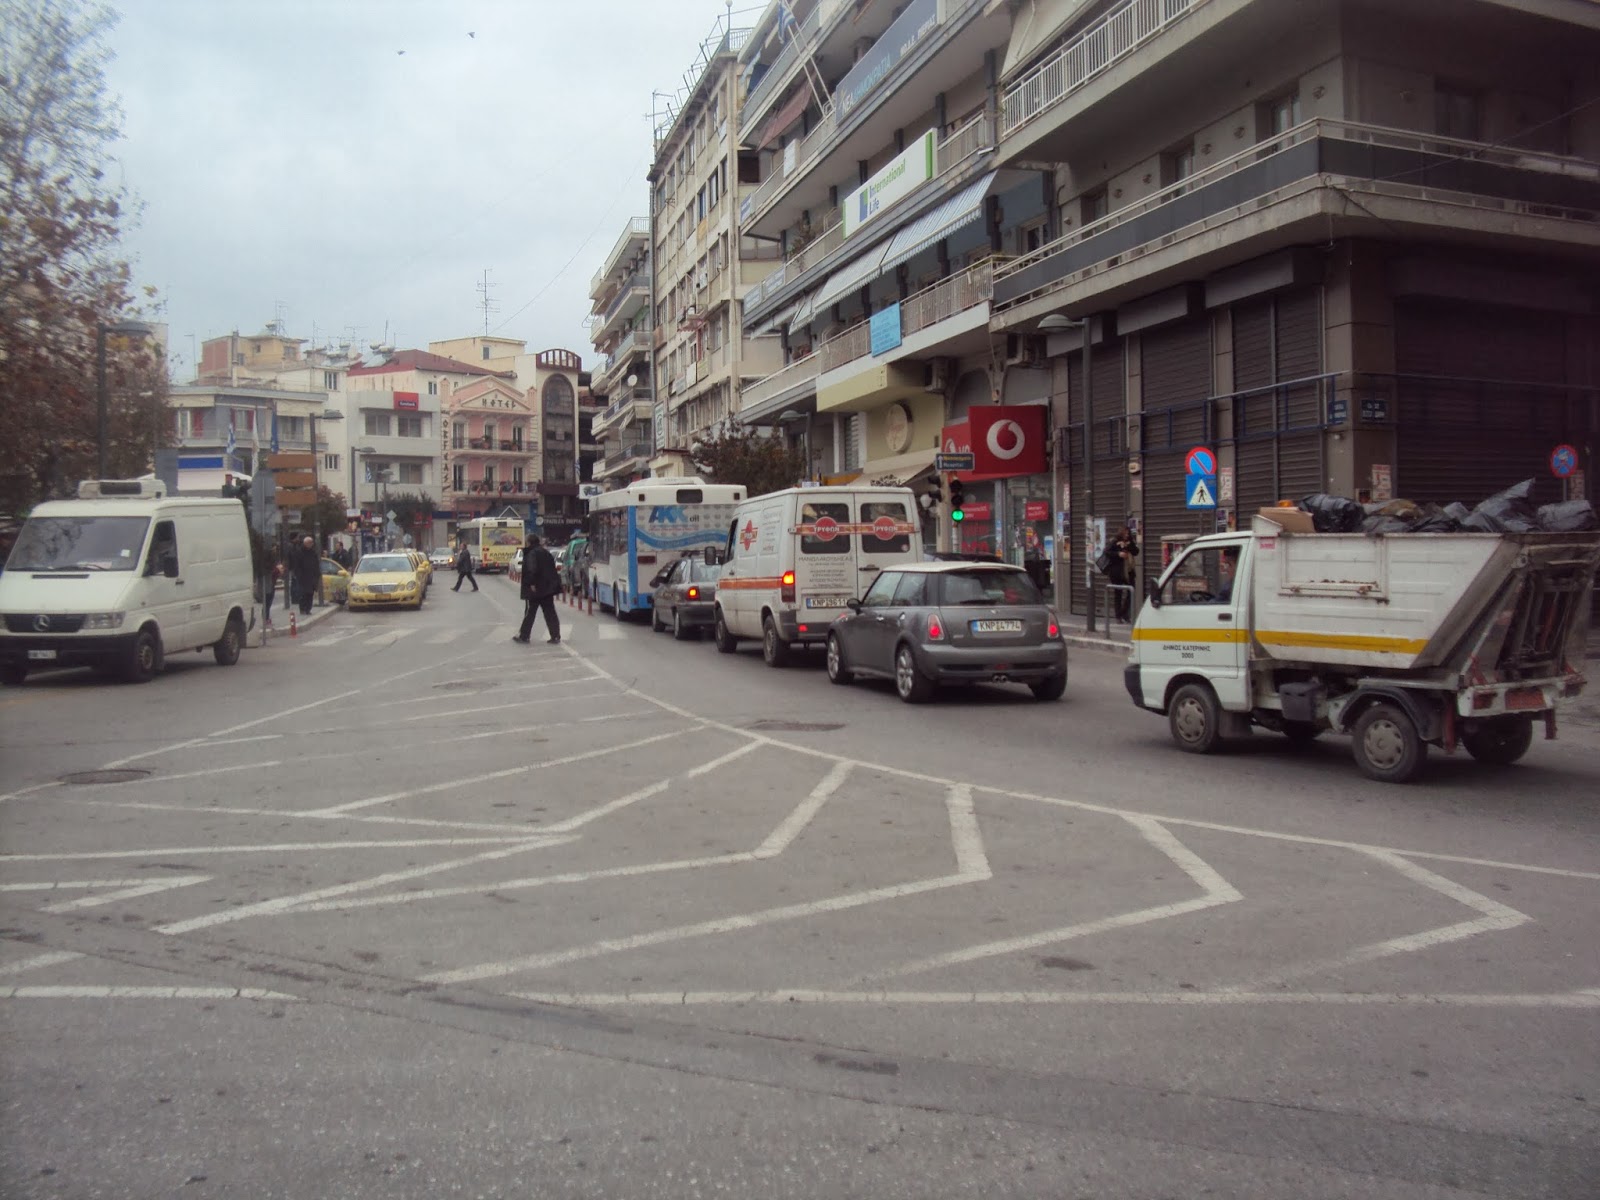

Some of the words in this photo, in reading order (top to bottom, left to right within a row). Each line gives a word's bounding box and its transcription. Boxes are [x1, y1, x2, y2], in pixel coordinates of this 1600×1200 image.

[869, 157, 906, 199] International
[869, 199, 880, 216] Life
[481, 398, 517, 409] HOTEL
